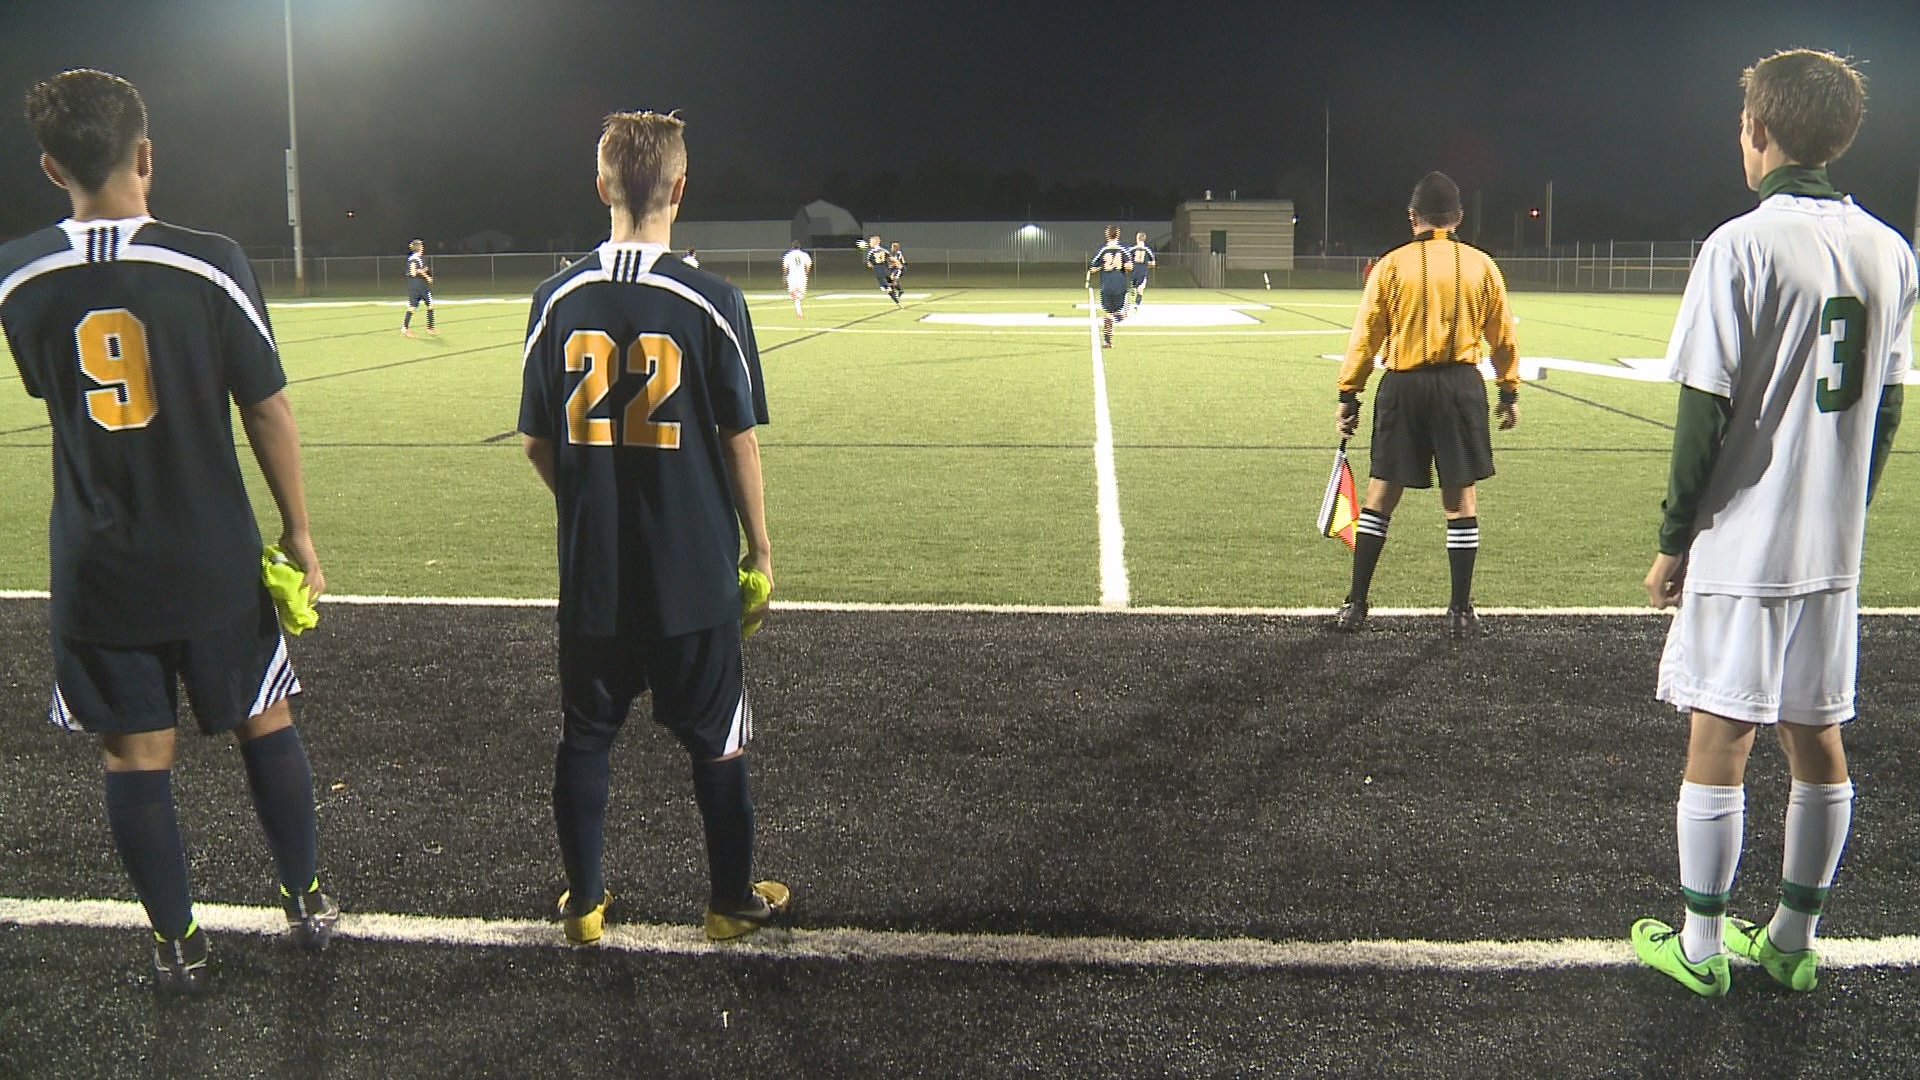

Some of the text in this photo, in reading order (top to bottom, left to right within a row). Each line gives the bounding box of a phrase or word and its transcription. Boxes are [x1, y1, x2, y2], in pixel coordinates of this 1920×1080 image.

[74, 307, 158, 431] 9
[563, 330, 683, 449] 22
[1816, 296, 1867, 413] 3
